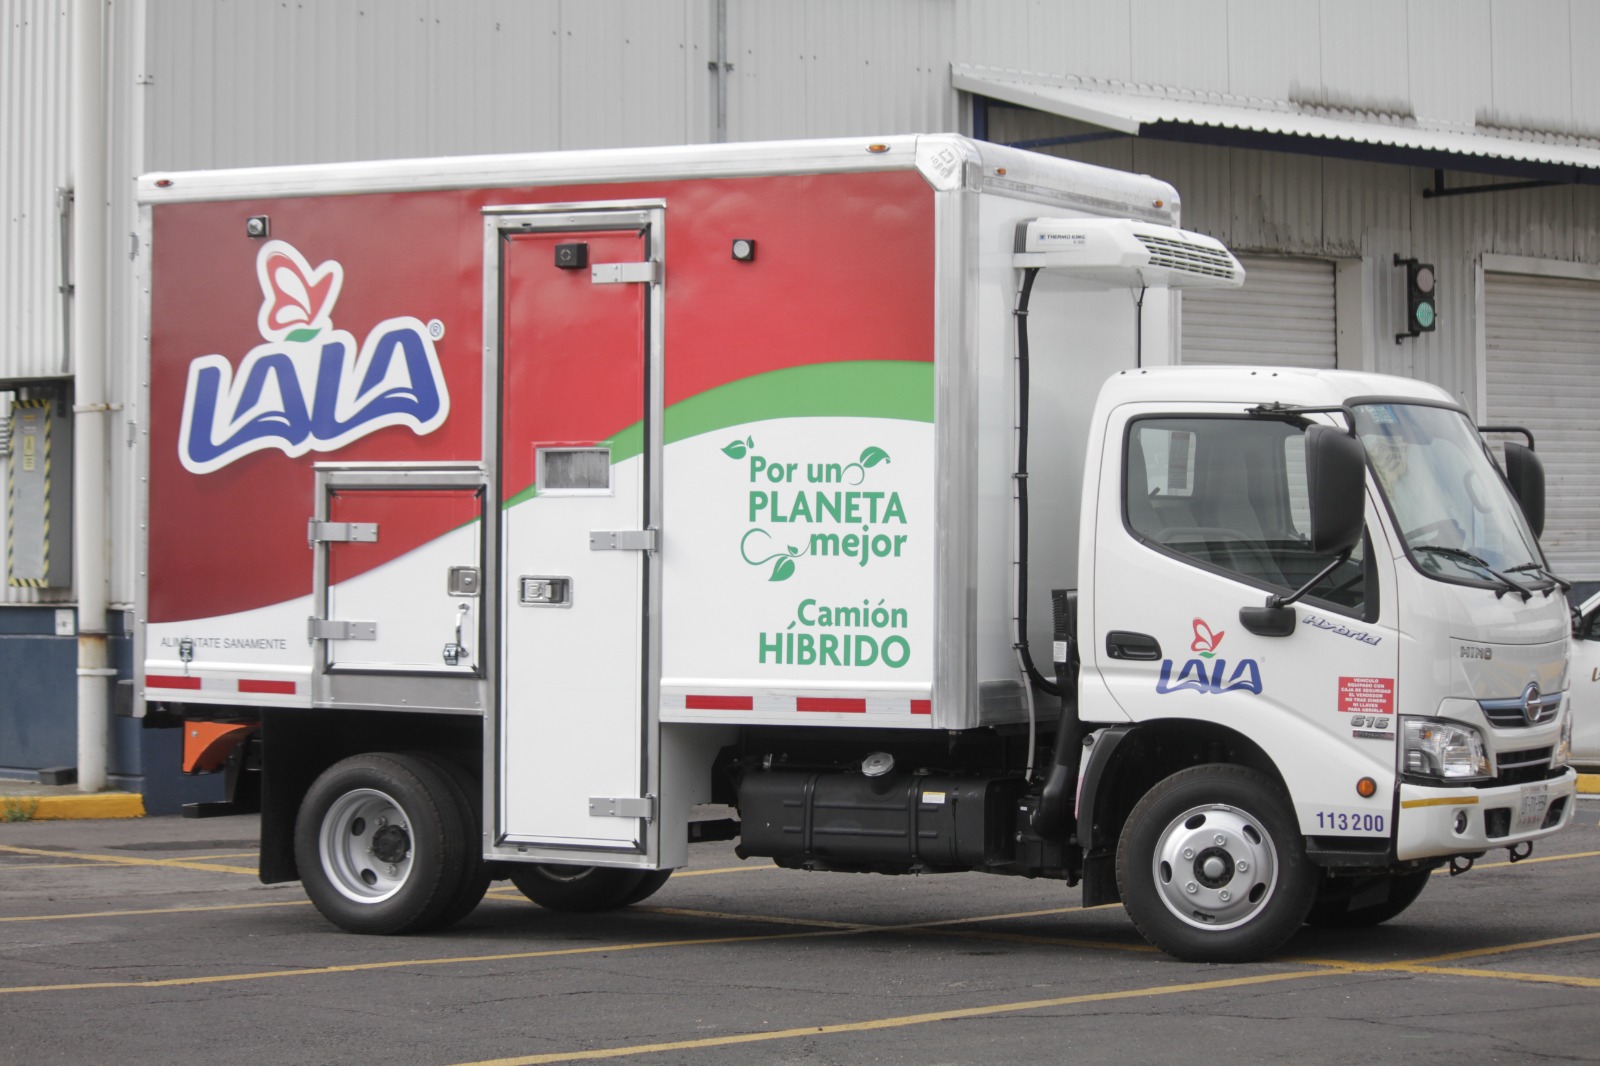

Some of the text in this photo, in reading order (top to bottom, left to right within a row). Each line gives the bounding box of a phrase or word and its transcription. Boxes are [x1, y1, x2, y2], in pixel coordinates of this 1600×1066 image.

[187, 327, 441, 464] LALA
[750, 455, 842, 483] Por un
[749, 490, 908, 524] PLANETA
[810, 524, 908, 567] mejor
[797, 598, 908, 628] Camión
[160, 636, 287, 650] ALIMNTATE SANAMENTE
[758, 620, 911, 668] HÍBRIDO
[1302, 614, 1383, 647] Hybrid
[1460, 645, 1493, 660] HINO
[1155, 658, 1263, 695] LALA
[1350, 714, 1390, 729] 616
[1316, 811, 1384, 832] 113200
